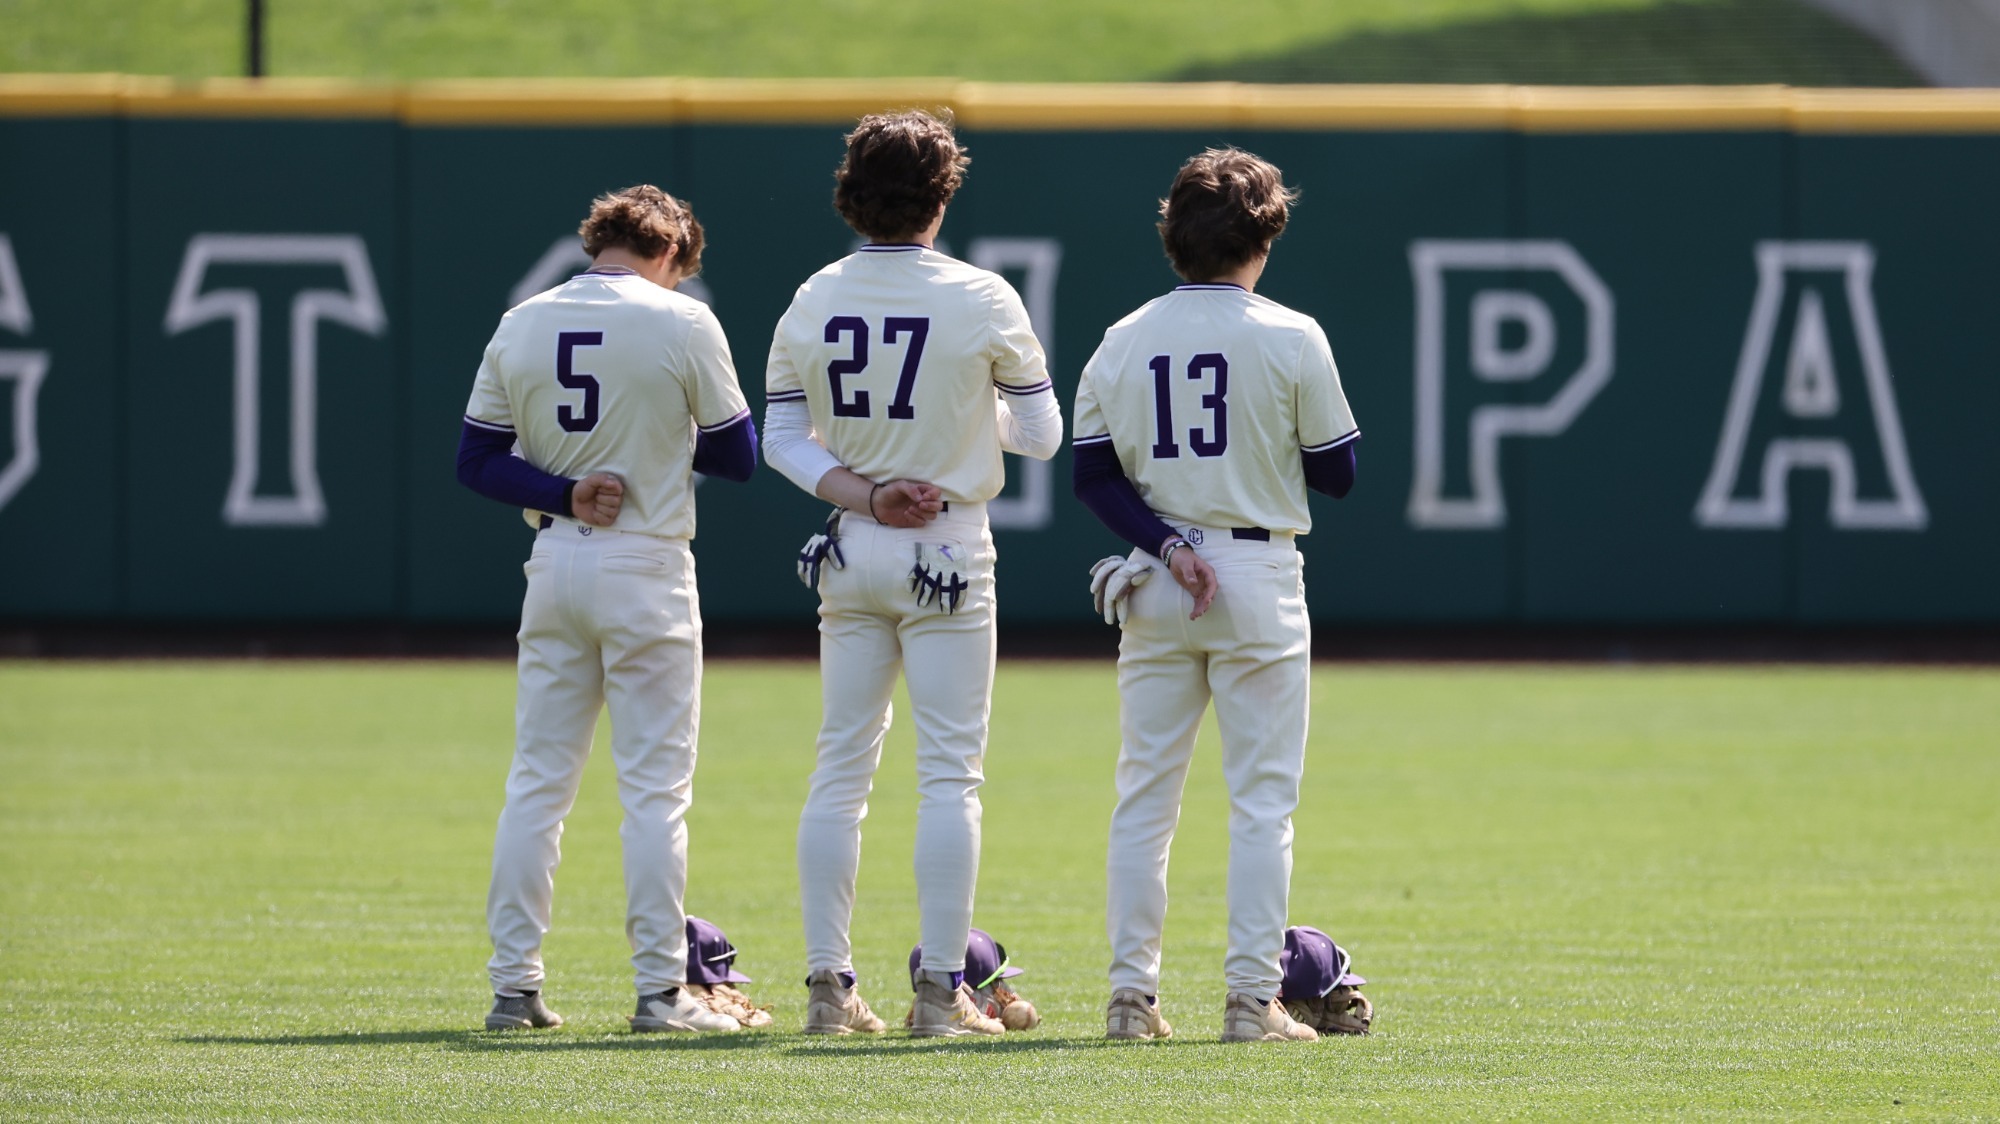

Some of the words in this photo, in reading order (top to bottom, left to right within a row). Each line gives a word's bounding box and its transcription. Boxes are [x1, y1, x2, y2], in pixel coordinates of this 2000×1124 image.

[556, 331, 604, 433] 5
[825, 316, 929, 420] 27
[1149, 353, 1228, 459] 13
